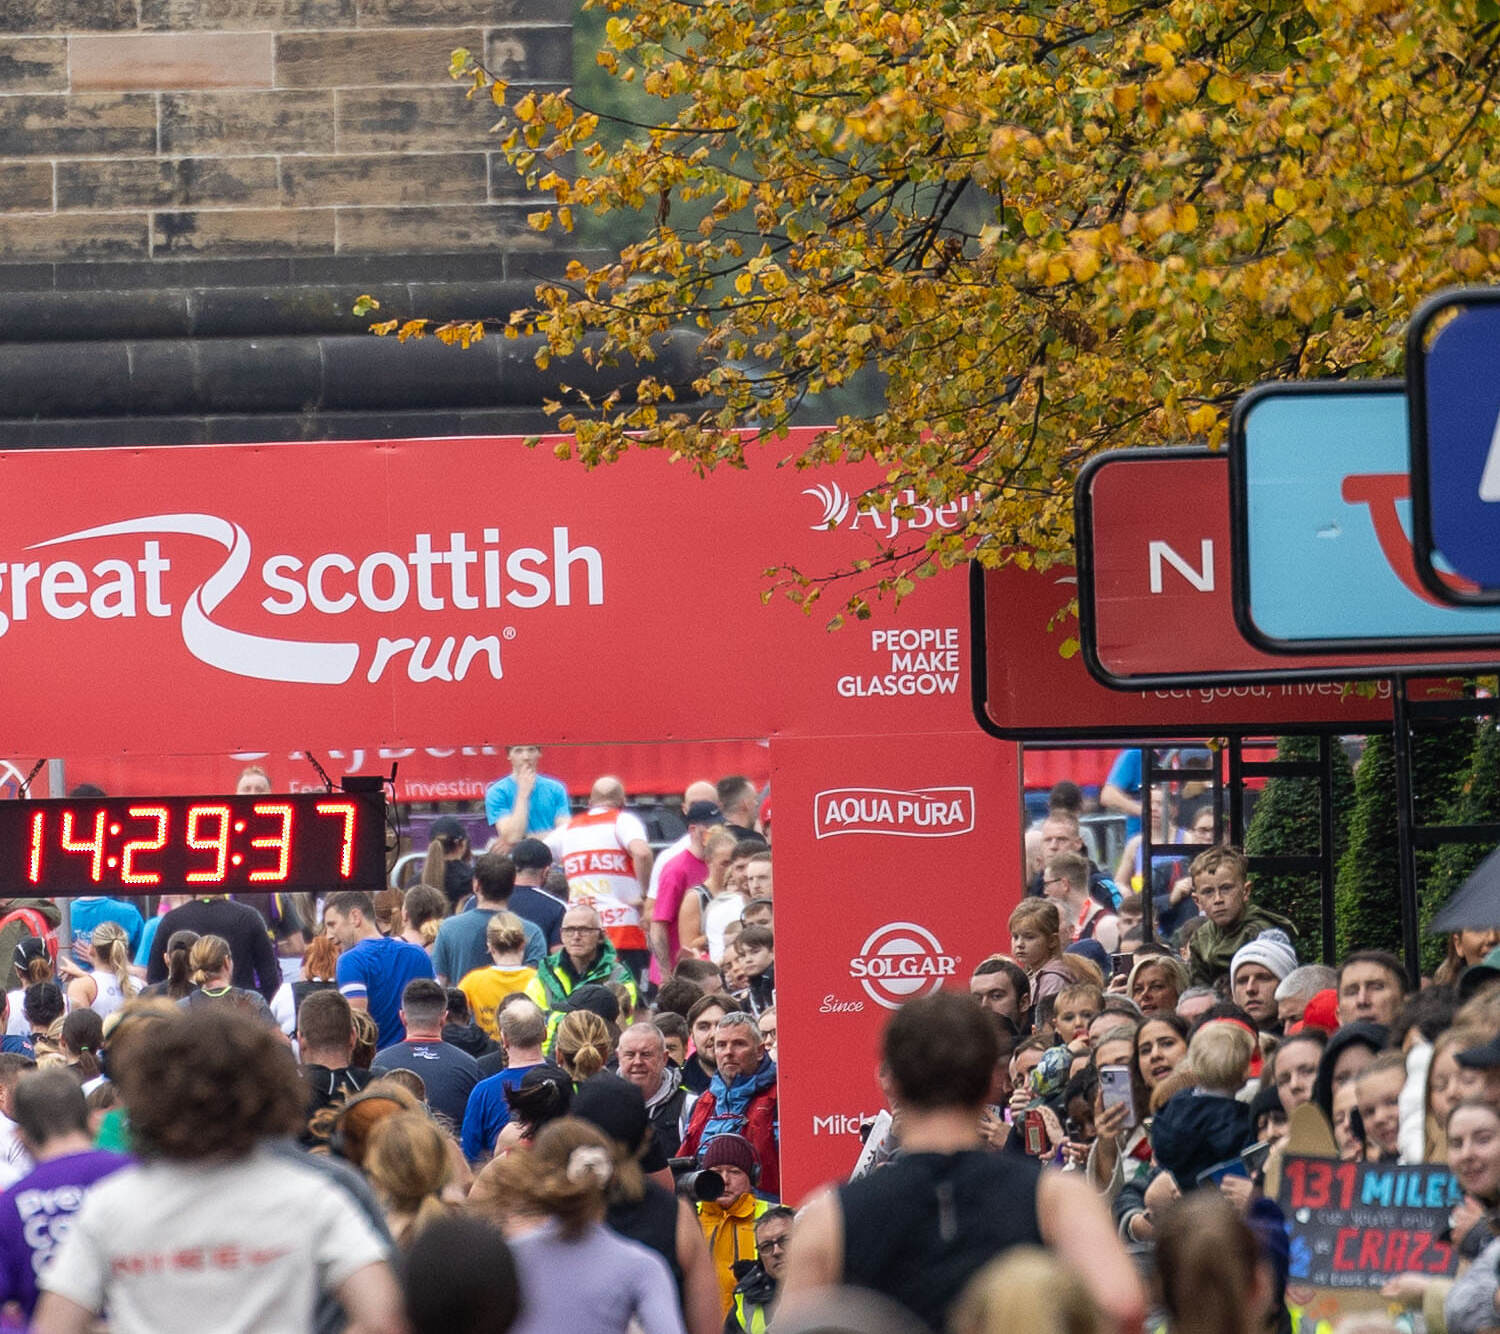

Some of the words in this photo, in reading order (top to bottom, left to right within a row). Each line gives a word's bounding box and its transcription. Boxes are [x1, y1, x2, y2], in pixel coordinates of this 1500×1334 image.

[260, 526, 605, 616] scottish
[871, 628, 960, 652] PEOPLE
[366, 634, 504, 684] run
[891, 650, 961, 673] MAKE
[836, 673, 960, 698] GLASGOW
[823, 797, 895, 827] AQUA
[897, 799, 965, 827] PURA
[29, 805, 356, 884] 14:29:37
[589, 853, 627, 873] ASK
[849, 956, 957, 978] SOLGAR
[819, 994, 865, 1013] Since
